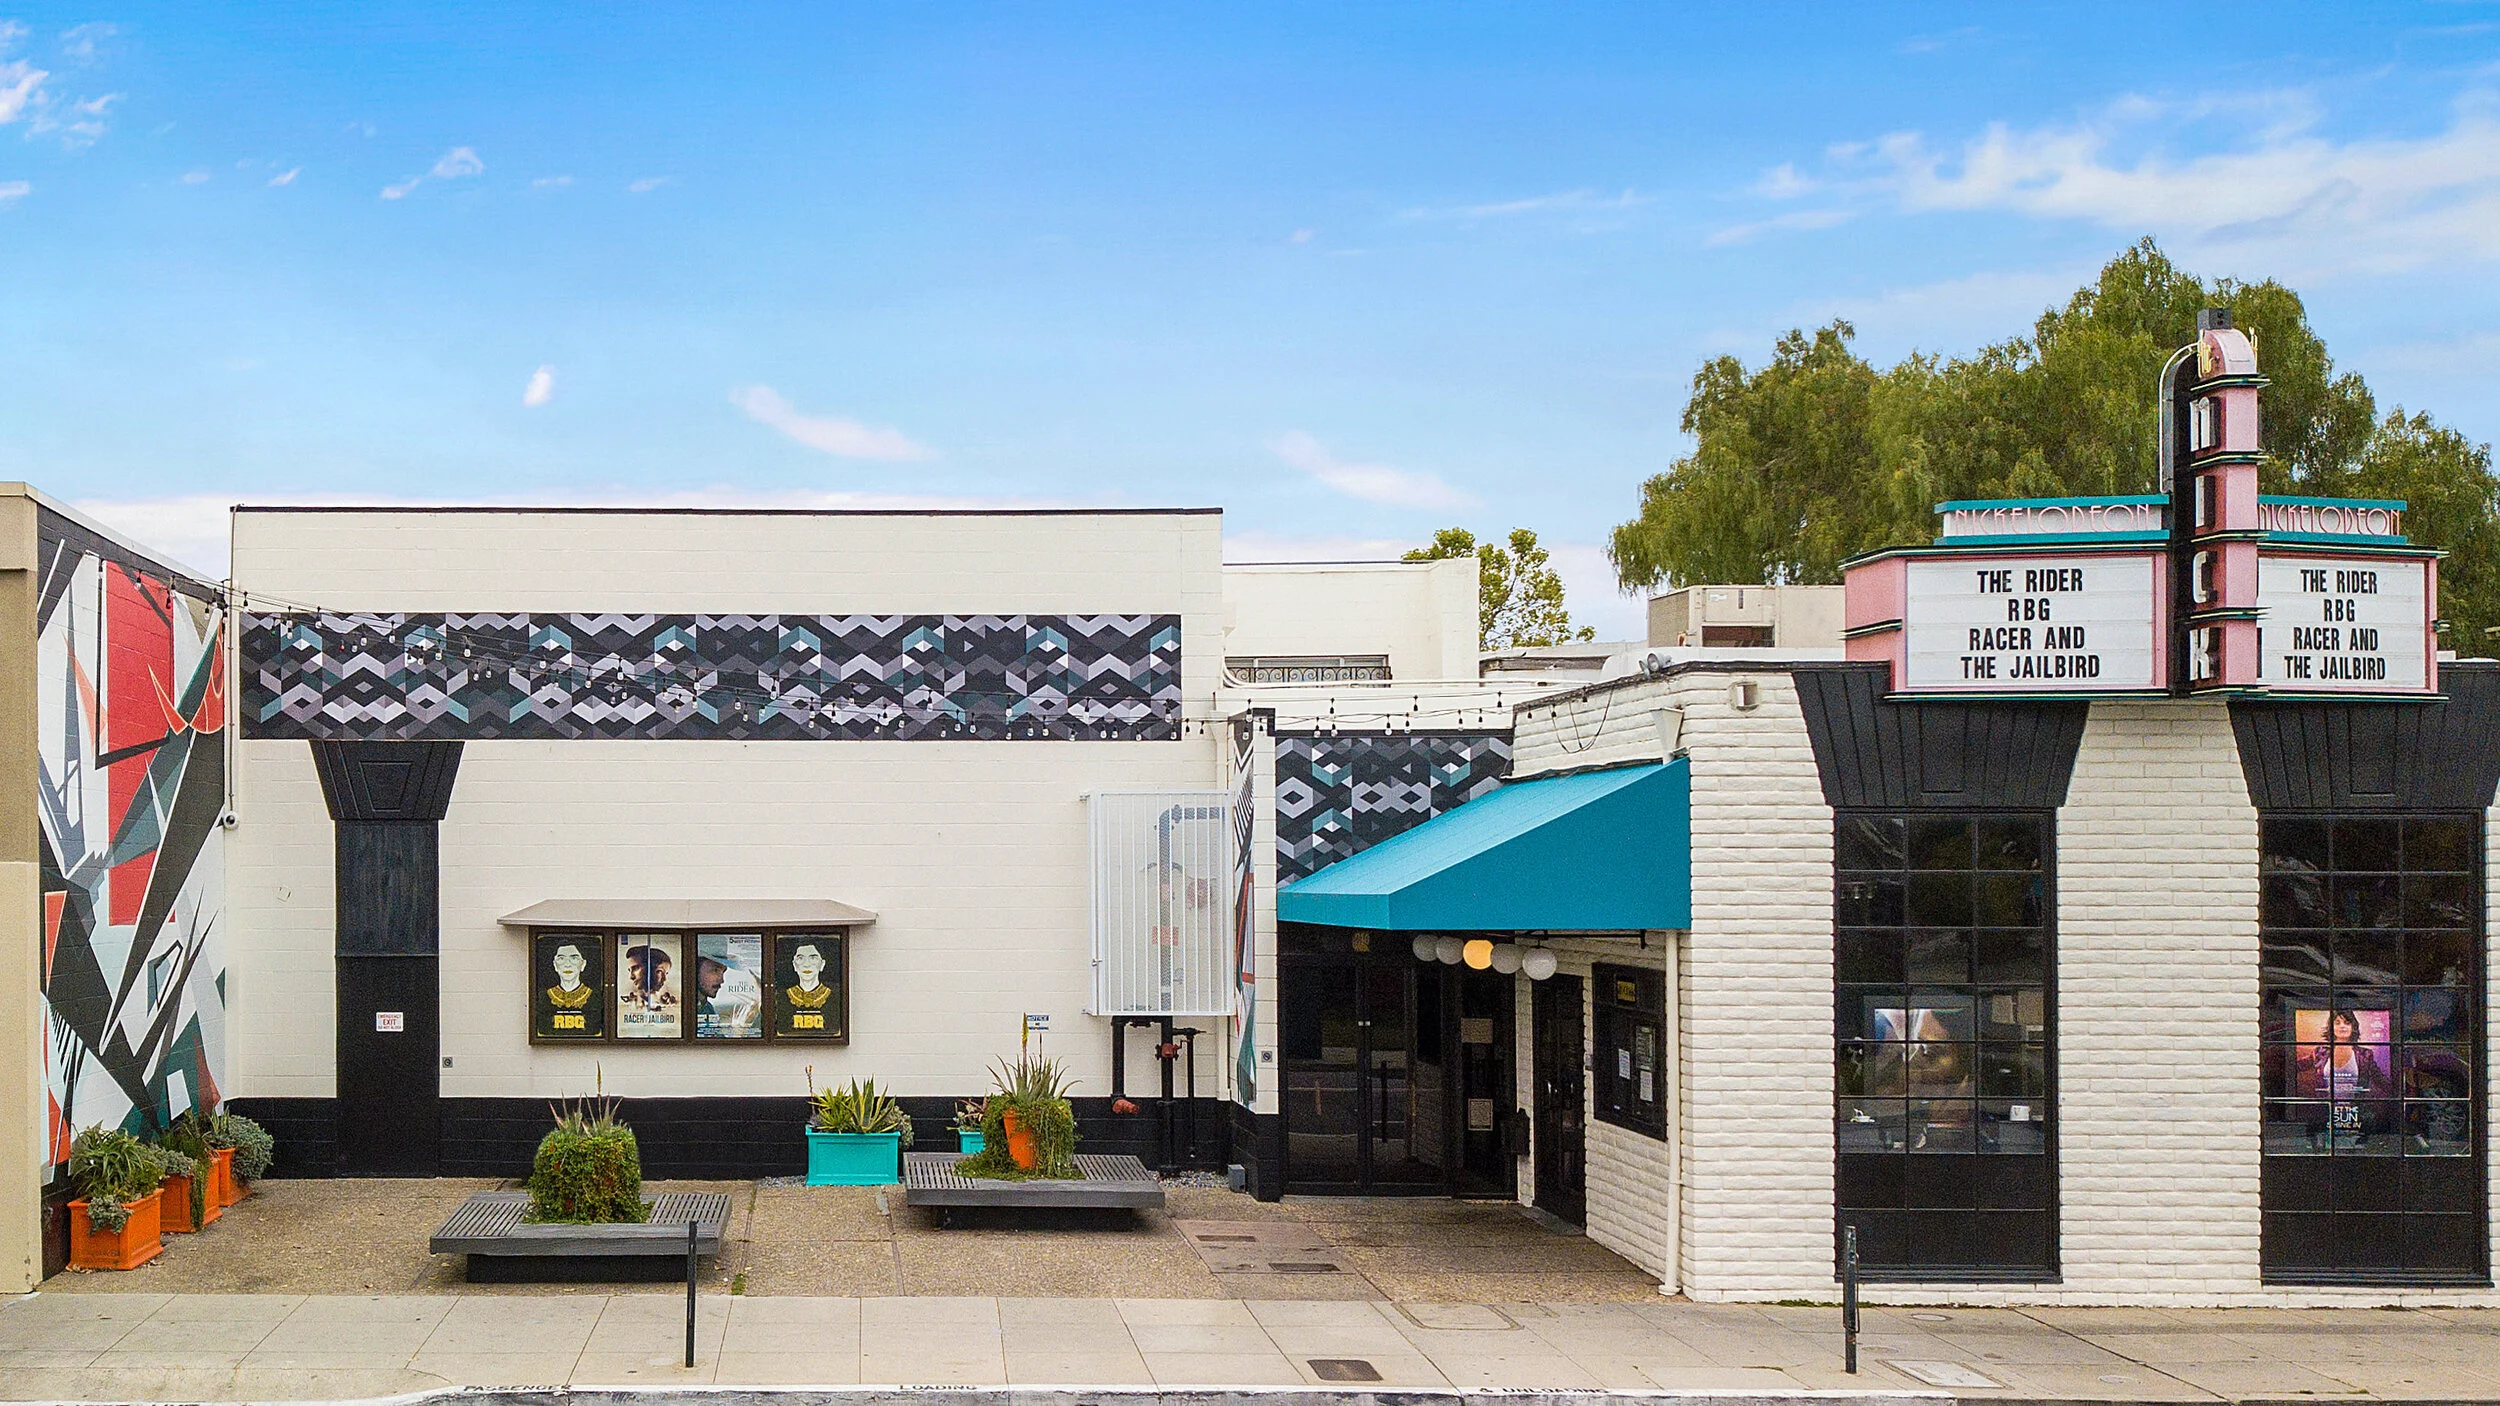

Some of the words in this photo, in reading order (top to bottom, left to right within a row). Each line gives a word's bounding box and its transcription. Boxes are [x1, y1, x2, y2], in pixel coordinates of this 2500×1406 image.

[1955, 504, 2151, 536] NICKELODEON
[2258, 503, 2400, 536] NICKELODEON
[1977, 569, 2012, 593] THE
[2026, 568, 2083, 592] RIDER
[2300, 569, 2327, 592] THE
[2336, 570, 2378, 594] RIDER
[2008, 598, 2050, 621] RBG
[2324, 599, 2355, 622] RBG
[1969, 627, 2032, 651] RACER
[2044, 626, 2085, 650] AND
[2293, 627, 2340, 650] RACER
[2349, 628, 2378, 651] AND
[1961, 656, 1997, 679] THE
[2010, 655, 2100, 679] JAILBIRD
[2284, 656, 2311, 679] THE
[2320, 656, 2386, 680] JAILBIRD
[728, 985, 755, 993] RIDER
[554, 1015, 586, 1029] RBG
[623, 1014, 645, 1024] RACER
[793, 1015, 824, 1029] RBG
[2333, 1112, 2358, 1122] SUN
[463, 1384, 571, 1392] PASSENGER
